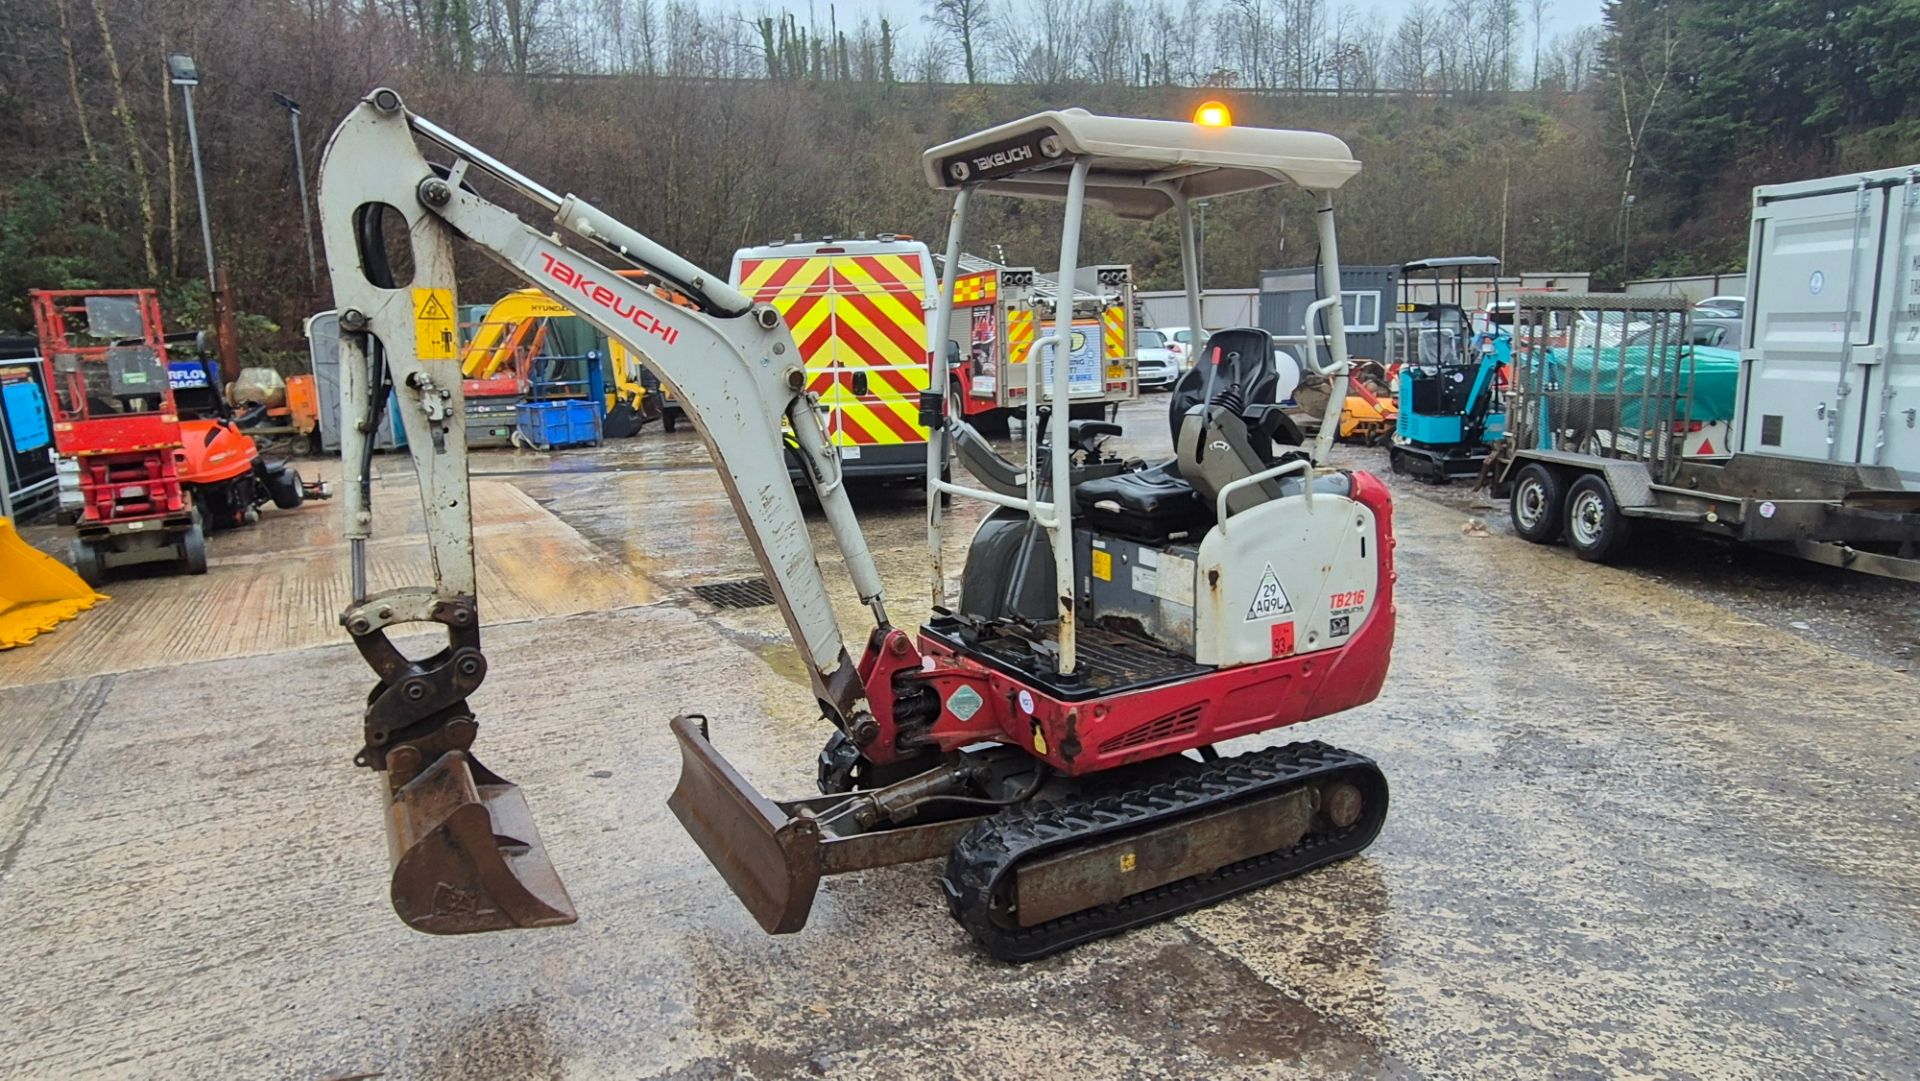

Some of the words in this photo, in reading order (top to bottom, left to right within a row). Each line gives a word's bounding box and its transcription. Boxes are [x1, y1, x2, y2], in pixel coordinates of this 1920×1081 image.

[972, 145, 1032, 171] TAKEUCHI
[540, 251, 680, 346] TAKEUCHI
[1263, 583, 1277, 598] 29
[1330, 589, 1365, 609] TB216
[1256, 597, 1284, 614] AQ9L
